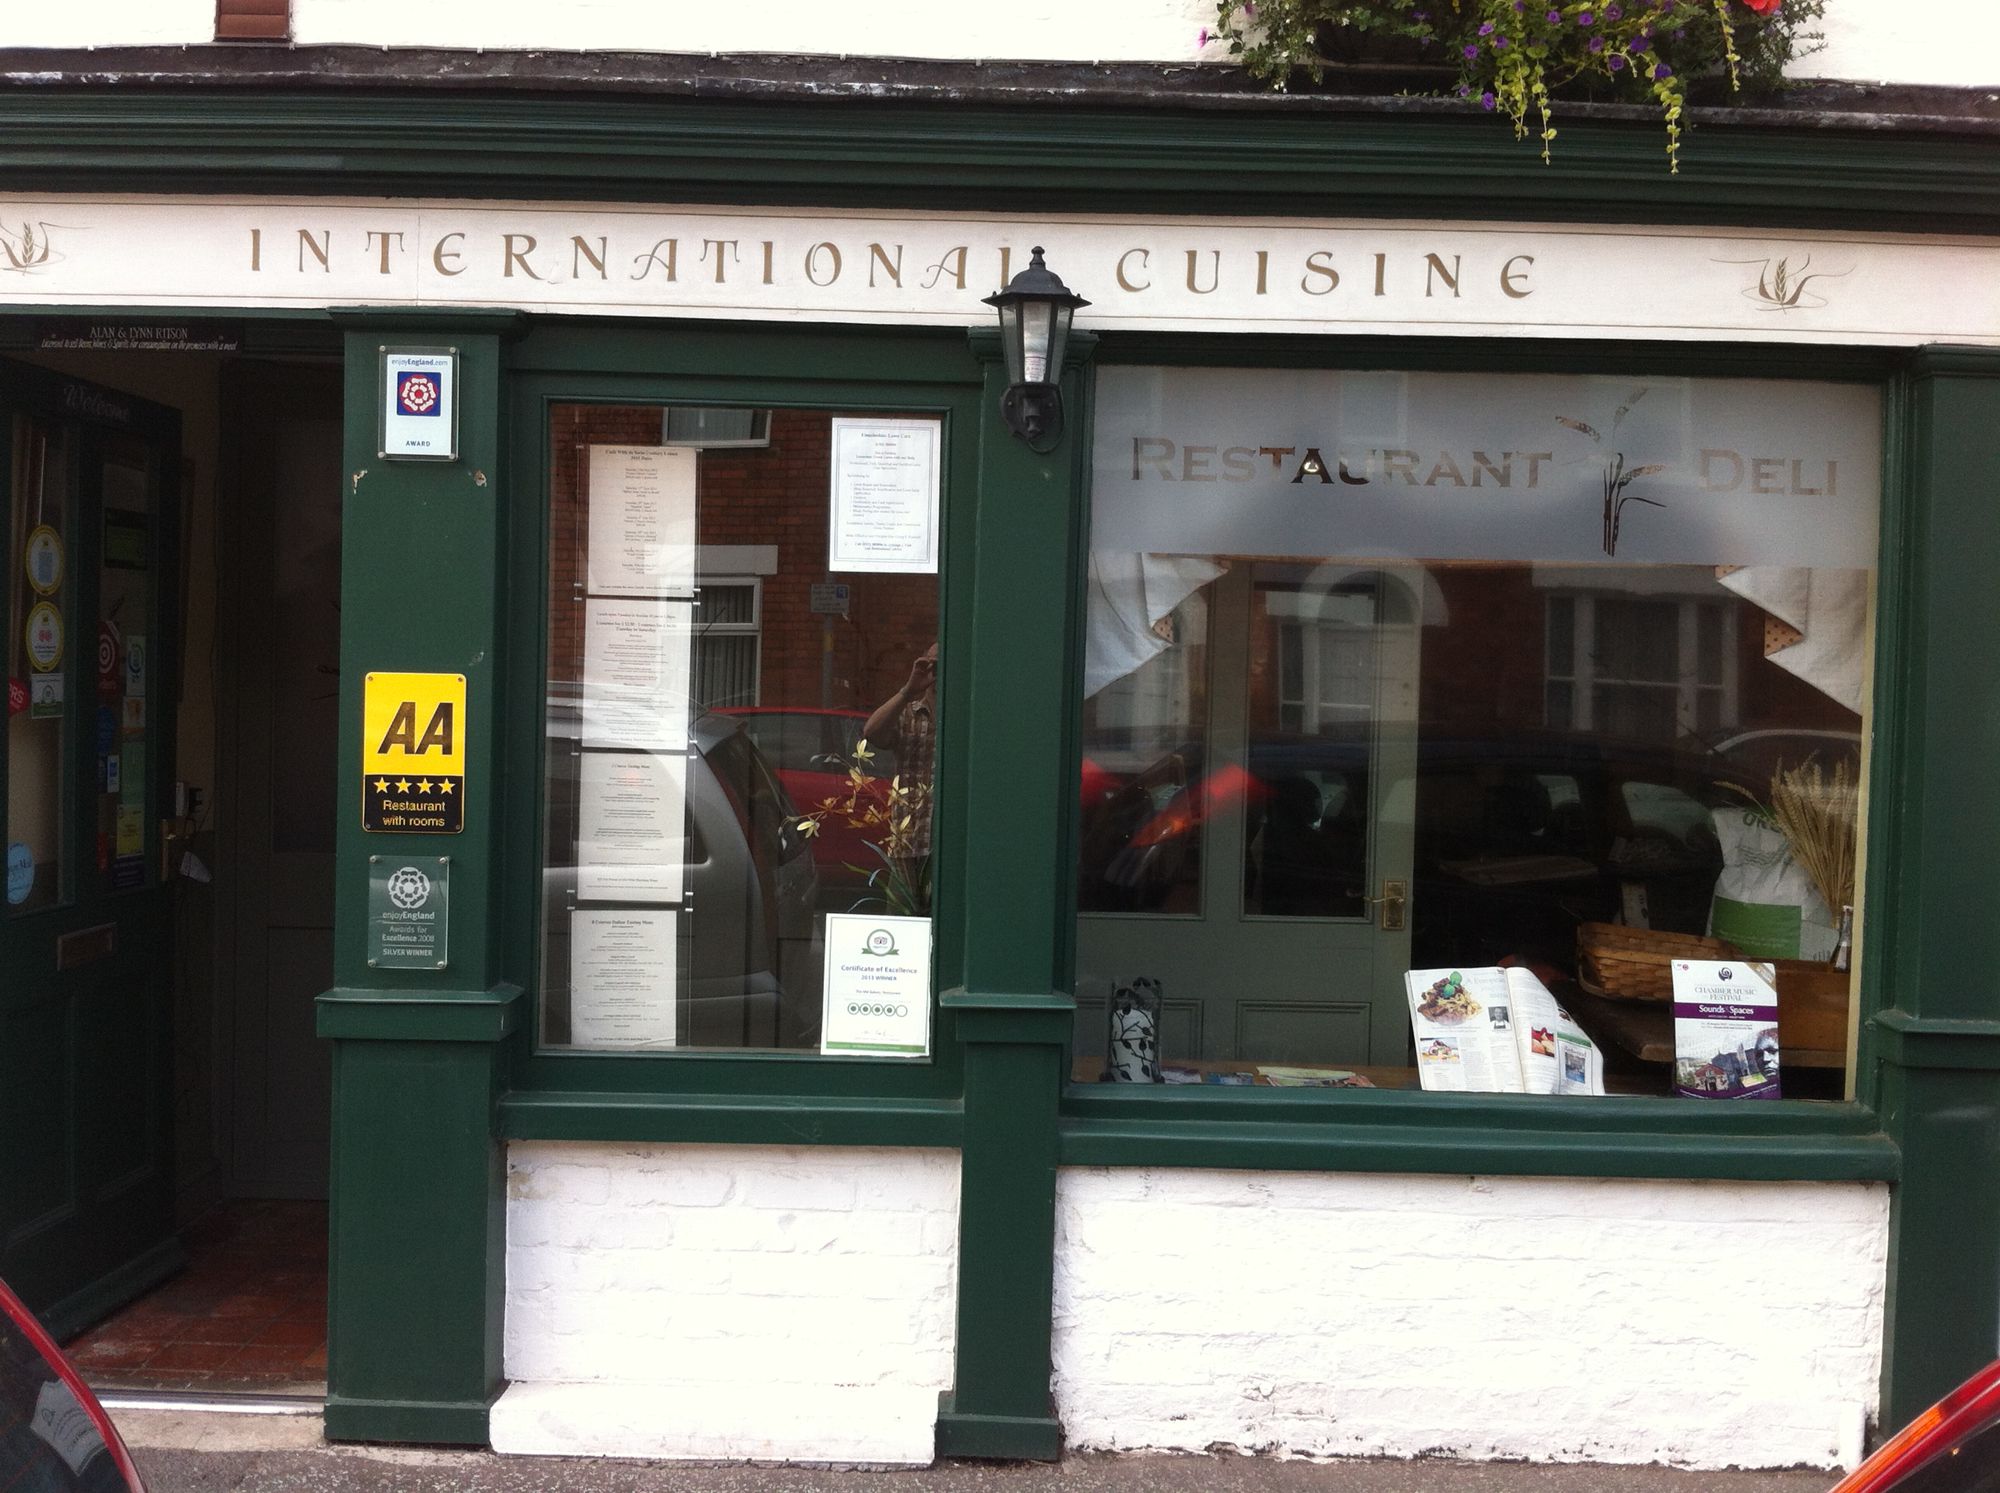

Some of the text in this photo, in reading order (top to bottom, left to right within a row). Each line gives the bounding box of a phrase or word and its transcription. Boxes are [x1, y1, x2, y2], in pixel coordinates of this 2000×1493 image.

[1116, 248, 1535, 299] CUISINE
[90, 327, 188, 340] ALAN & LYNN RITSON
[391, 358, 448, 367] enjoyEngland.com
[1131, 437, 1838, 497] RESTAURANT DELI
[377, 701, 453, 755] AA
[383, 800, 446, 812] Restaurant
[383, 816, 445, 828] with rooms
[382, 911, 435, 921] enjoyEngland
[389, 925, 427, 934] Awards for
[382, 933, 417, 942] Excellence
[382, 948, 433, 957] SILVER WINNER
[841, 965, 875, 973] Certificate
[1694, 986, 1757, 996] CHAMBER MUSIC
[1709, 994, 1743, 1002] FESTIVAL
[1699, 1004, 1726, 1013] Sounds
[1729, 1006, 1754, 1016] Spaces
